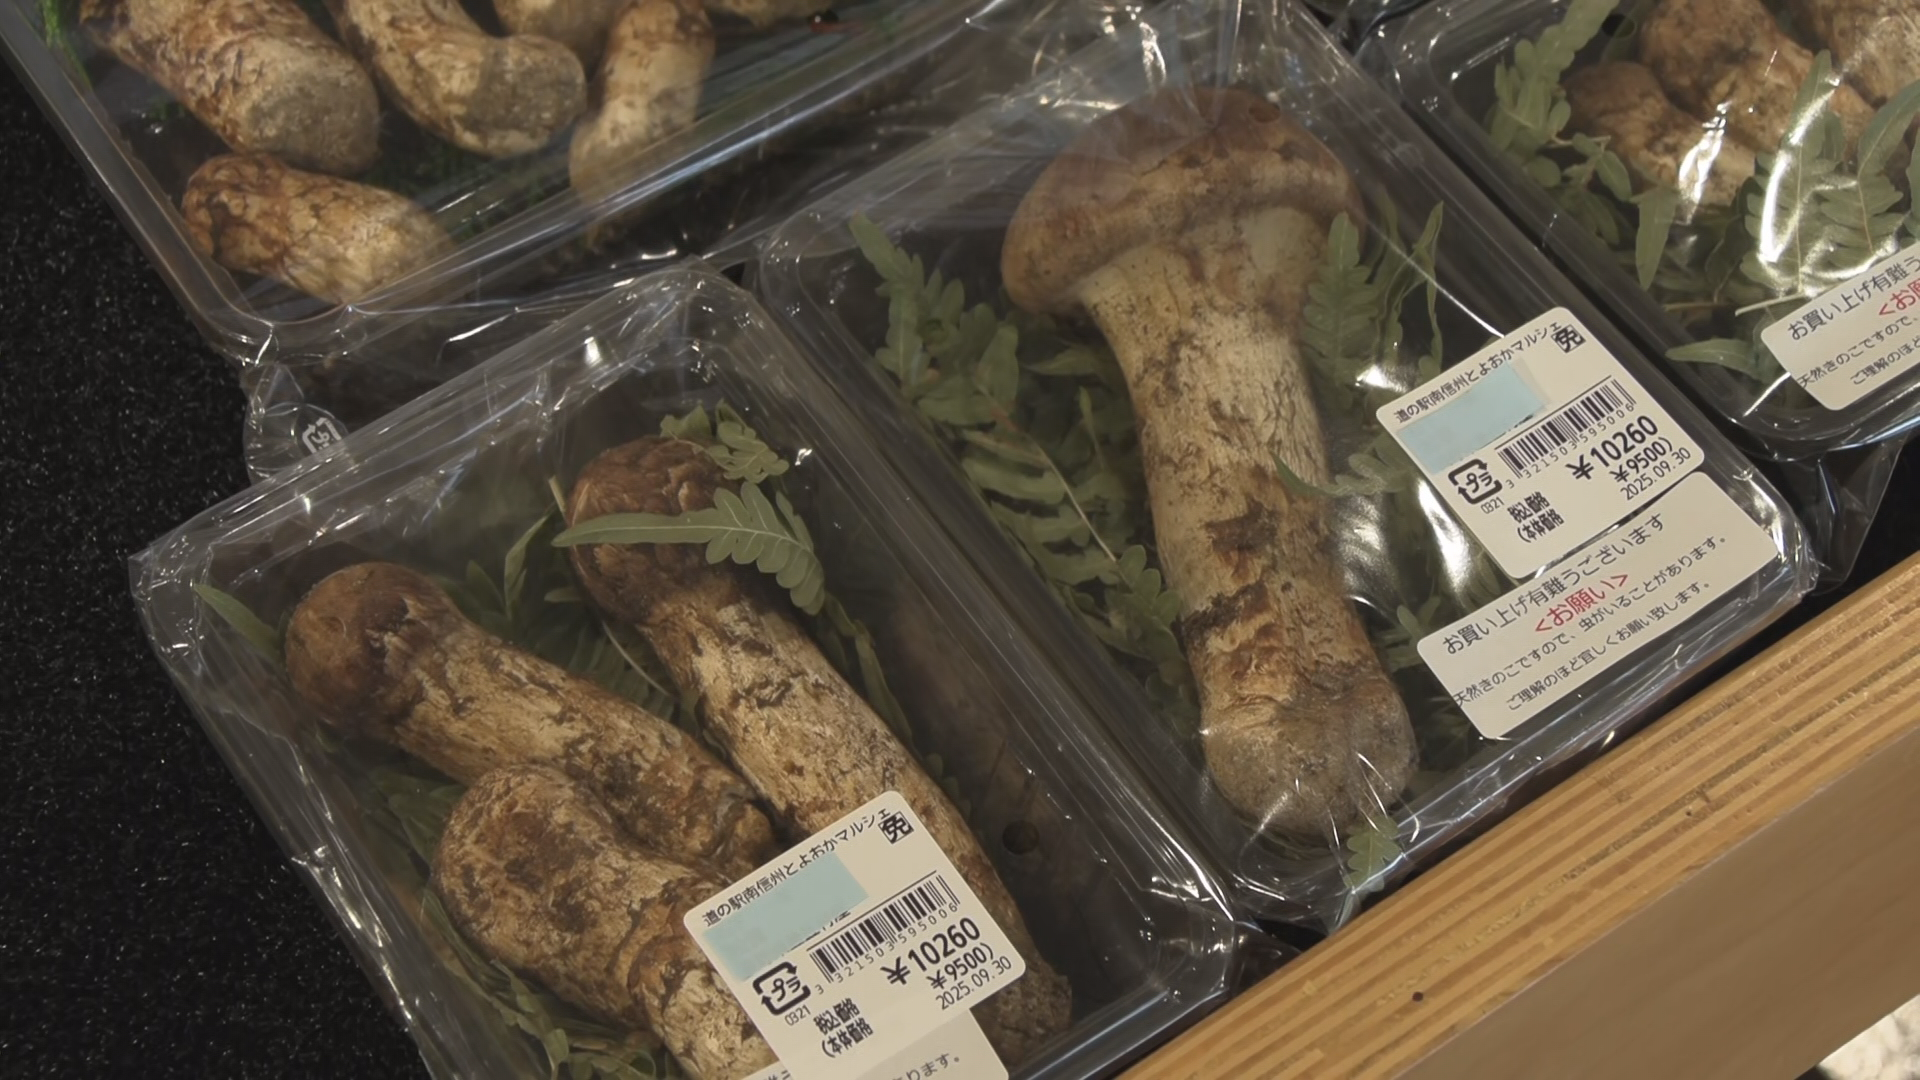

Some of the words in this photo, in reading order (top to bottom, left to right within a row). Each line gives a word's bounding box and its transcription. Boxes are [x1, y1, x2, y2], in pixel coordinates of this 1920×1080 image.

[1565, 414, 1658, 481] ¥10260
[1609, 436, 1673, 484] ¥9500)
[1620, 446, 1692, 501] 2025.09.30
[1480, 497, 1505, 515] 0321
[1442, 513, 1665, 655] お買い上げ有難うございます
[1506, 581, 1710, 712] ご理解のほど宜しくお願い致します。
[880, 917, 981, 986] ¥10260
[926, 942, 994, 991] ¥9500)
[935, 955, 1012, 1011] 2025.09.30
[784, 1005, 811, 1027] 0321
